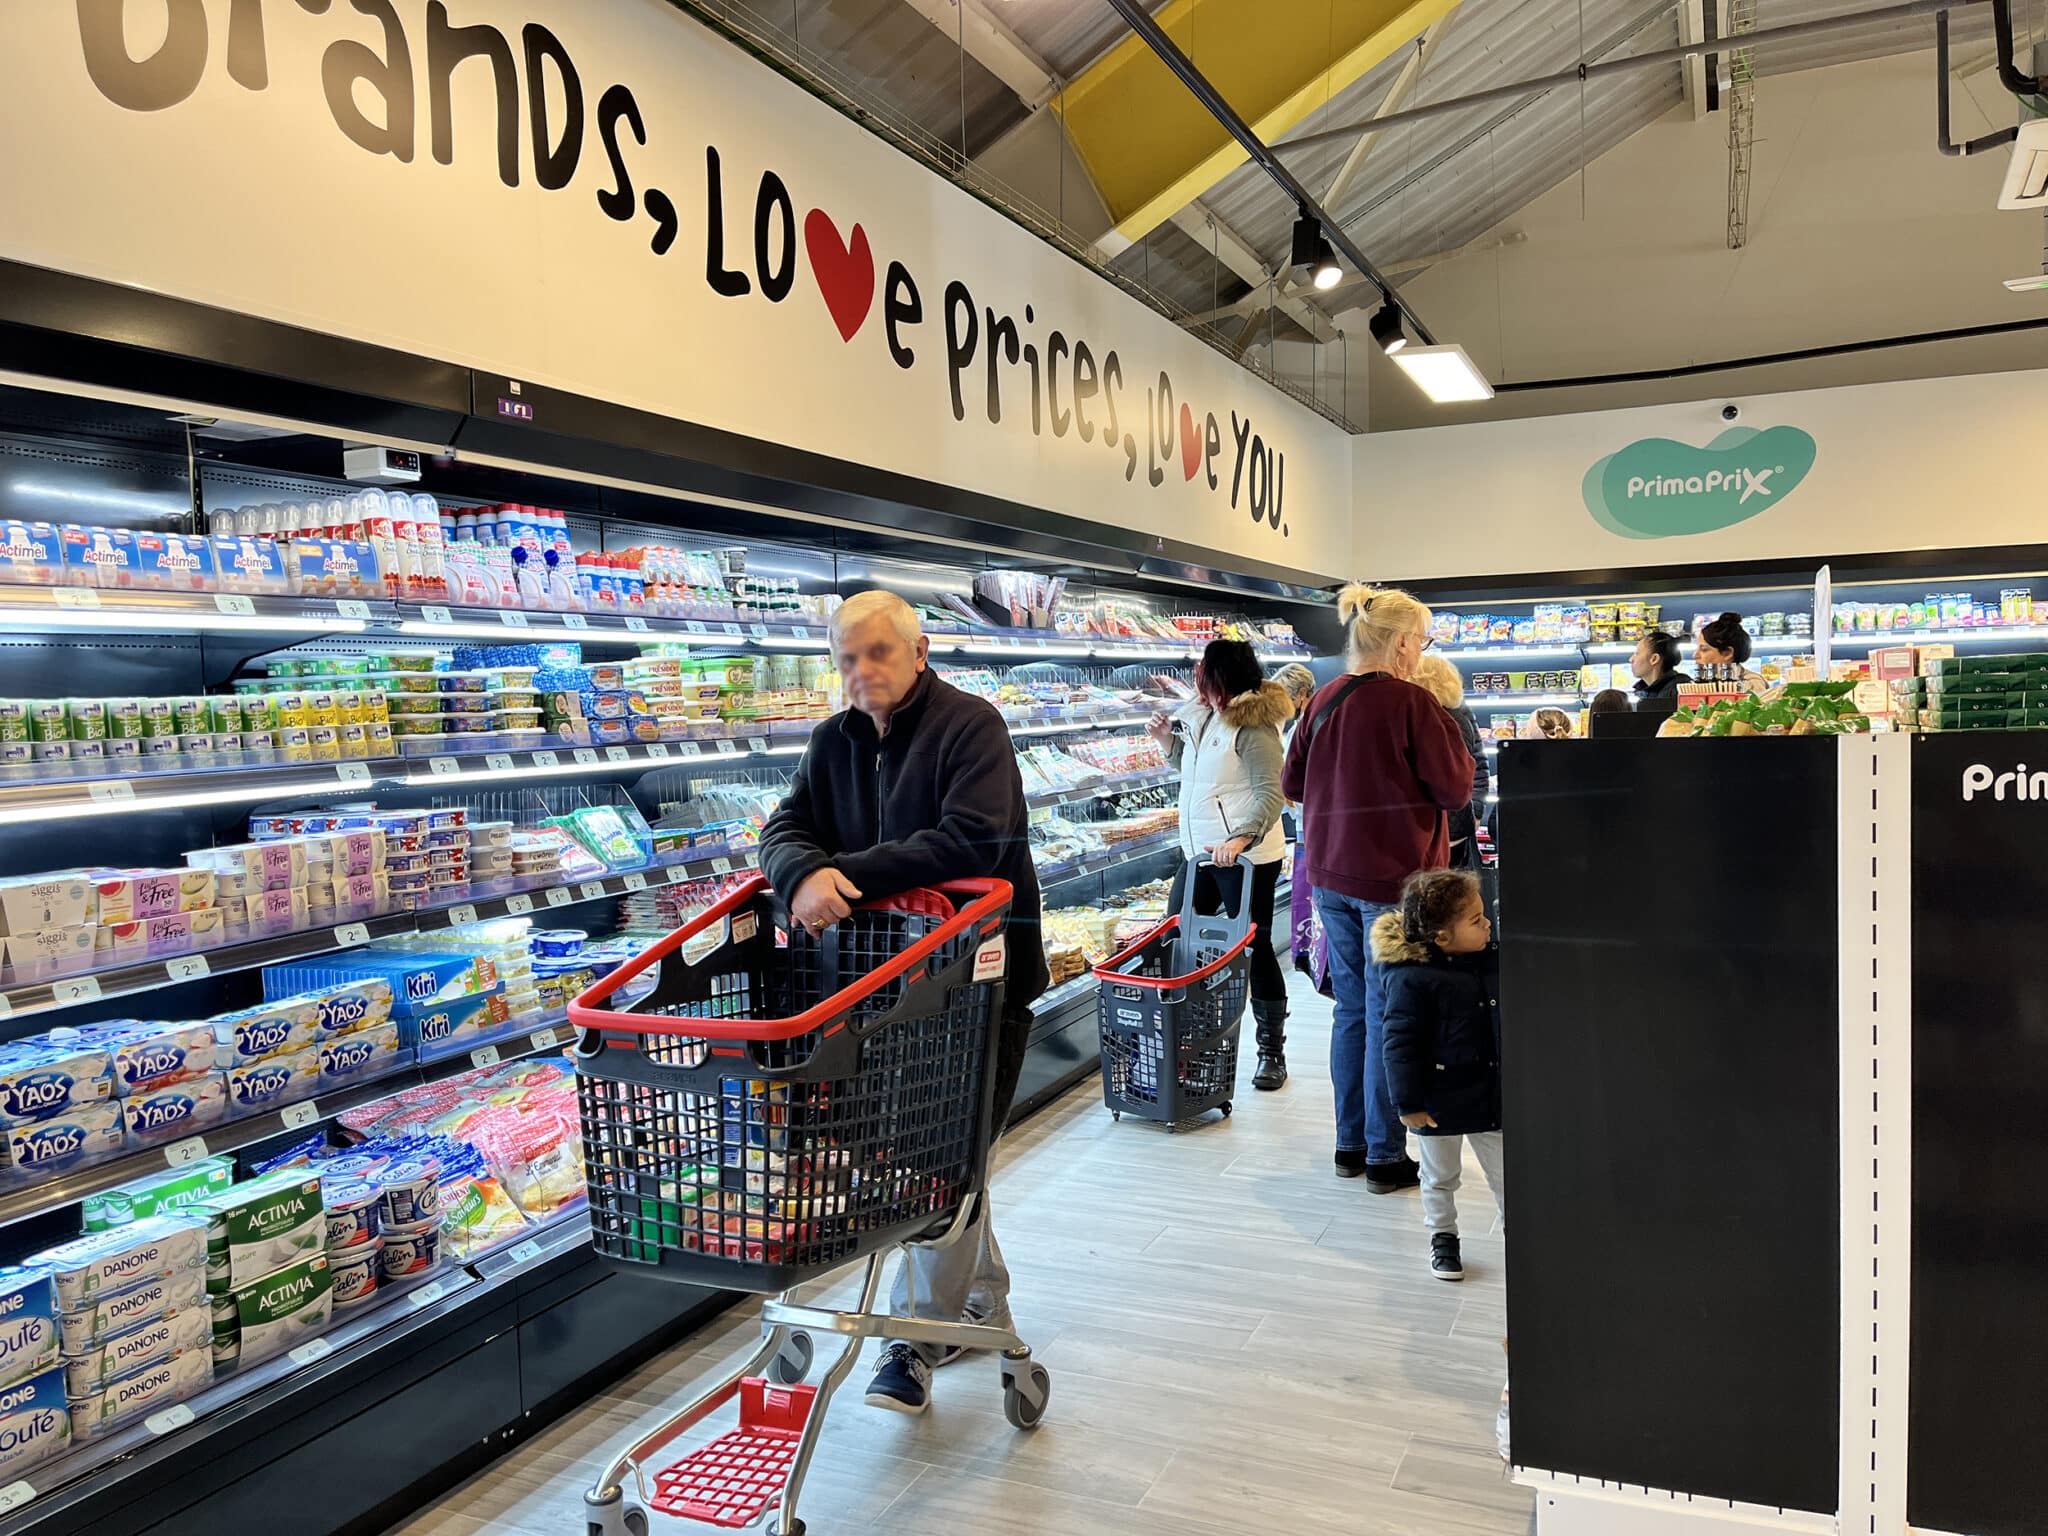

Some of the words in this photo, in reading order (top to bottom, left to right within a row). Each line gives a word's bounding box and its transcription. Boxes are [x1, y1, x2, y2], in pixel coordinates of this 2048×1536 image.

[1230, 409, 1290, 537] YOU.
[85, 549, 127, 564] Actimel
[158, 555, 200, 568] Actimel
[325, 558, 357, 571] Actimel
[124, 726, 140, 737] Bio
[153, 726, 169, 737] Bio
[182, 723, 199, 734] Bio
[289, 717, 303, 727] Bio
[320, 715, 333, 725] Bio
[372, 713, 385, 724] Bio
[2, 729, 20, 741] Bio
[44, 729, 61, 741] Bio
[87, 727, 103, 739] Bio
[407, 971, 437, 998] Kiri
[327, 1000, 363, 1025] YAOS
[245, 1021, 287, 1050] YAOS
[420, 1013, 450, 1041] Kiri
[130, 1046, 180, 1078] YAOS
[332, 1044, 369, 1070] YAOS
[12, 1077, 66, 1109] YAOS
[242, 1070, 286, 1098] YAOS
[139, 1100, 188, 1129] YAOS
[26, 1128, 80, 1162] YAOS
[154, 1185, 210, 1216] ACTIVIA
[248, 1198, 305, 1231] ACTIVIA
[327, 1222, 354, 1238] alin
[104, 1248, 158, 1278] DANONE
[234, 1250, 257, 1265] nature
[382, 1247, 413, 1264] Calin
[258, 1276, 314, 1312] ACTIVIA
[332, 1272, 366, 1292] Calin
[111, 1287, 162, 1317] DANONE
[118, 1328, 169, 1358] DANONE
[0, 1385, 36, 1412] ONE
[120, 1370, 171, 1402] DANONE
